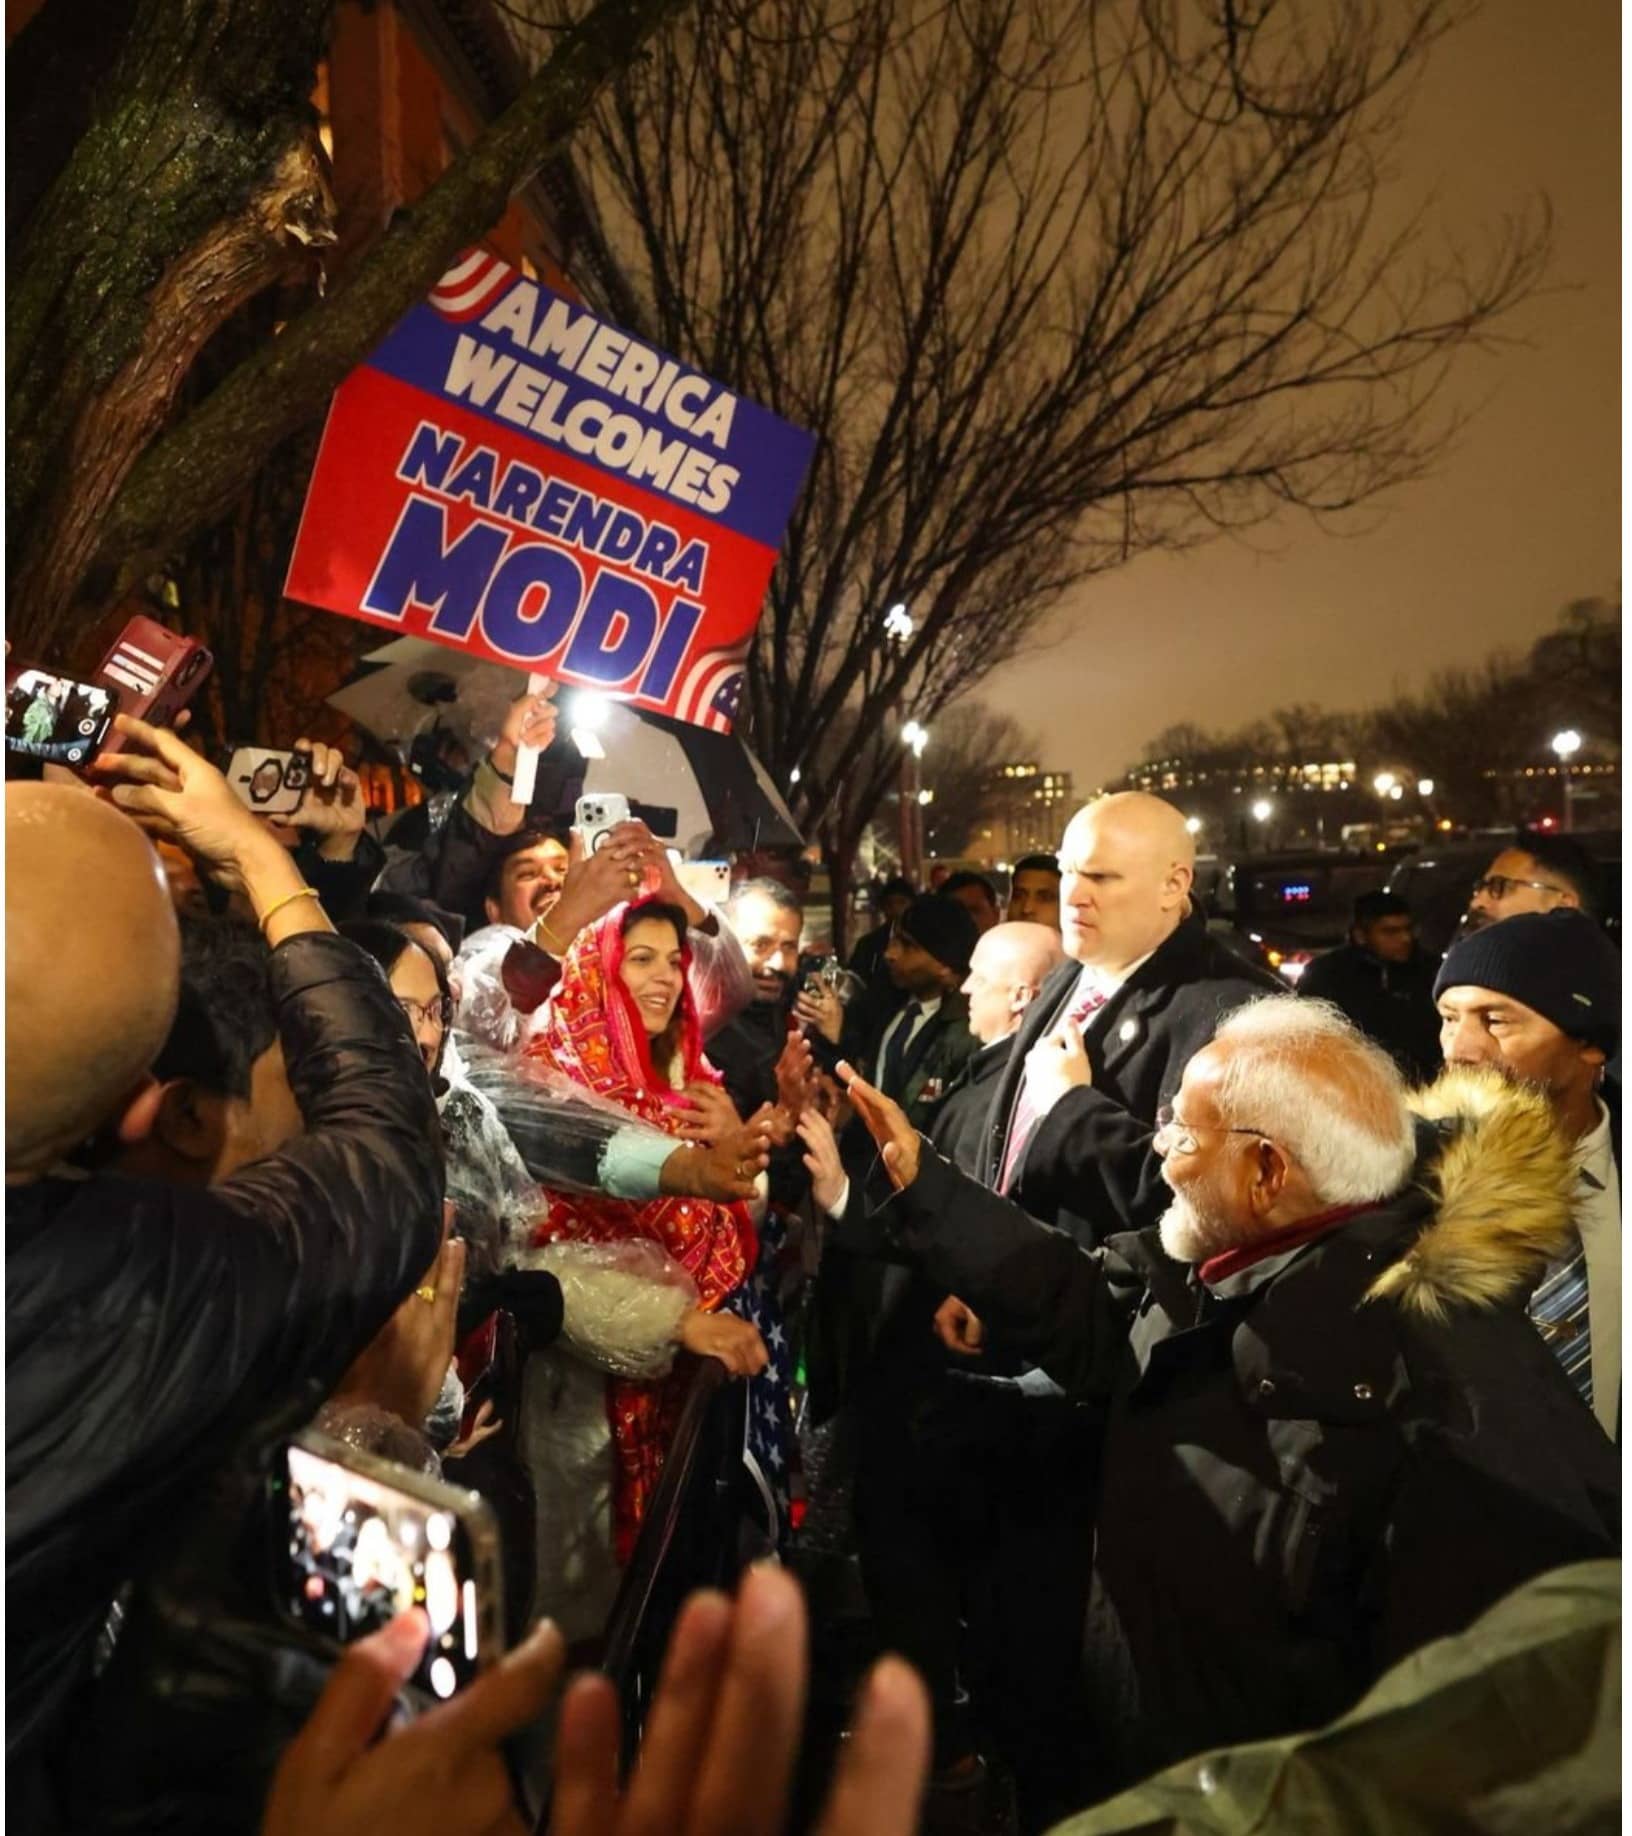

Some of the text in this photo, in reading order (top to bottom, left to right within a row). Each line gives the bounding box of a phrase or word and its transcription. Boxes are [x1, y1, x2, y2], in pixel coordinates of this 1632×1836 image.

[443, 334, 740, 514] WELCOMES
[480, 282, 737, 448] AMERICA
[359, 493, 705, 702] MODI
[397, 421, 710, 597] NARENDRA
